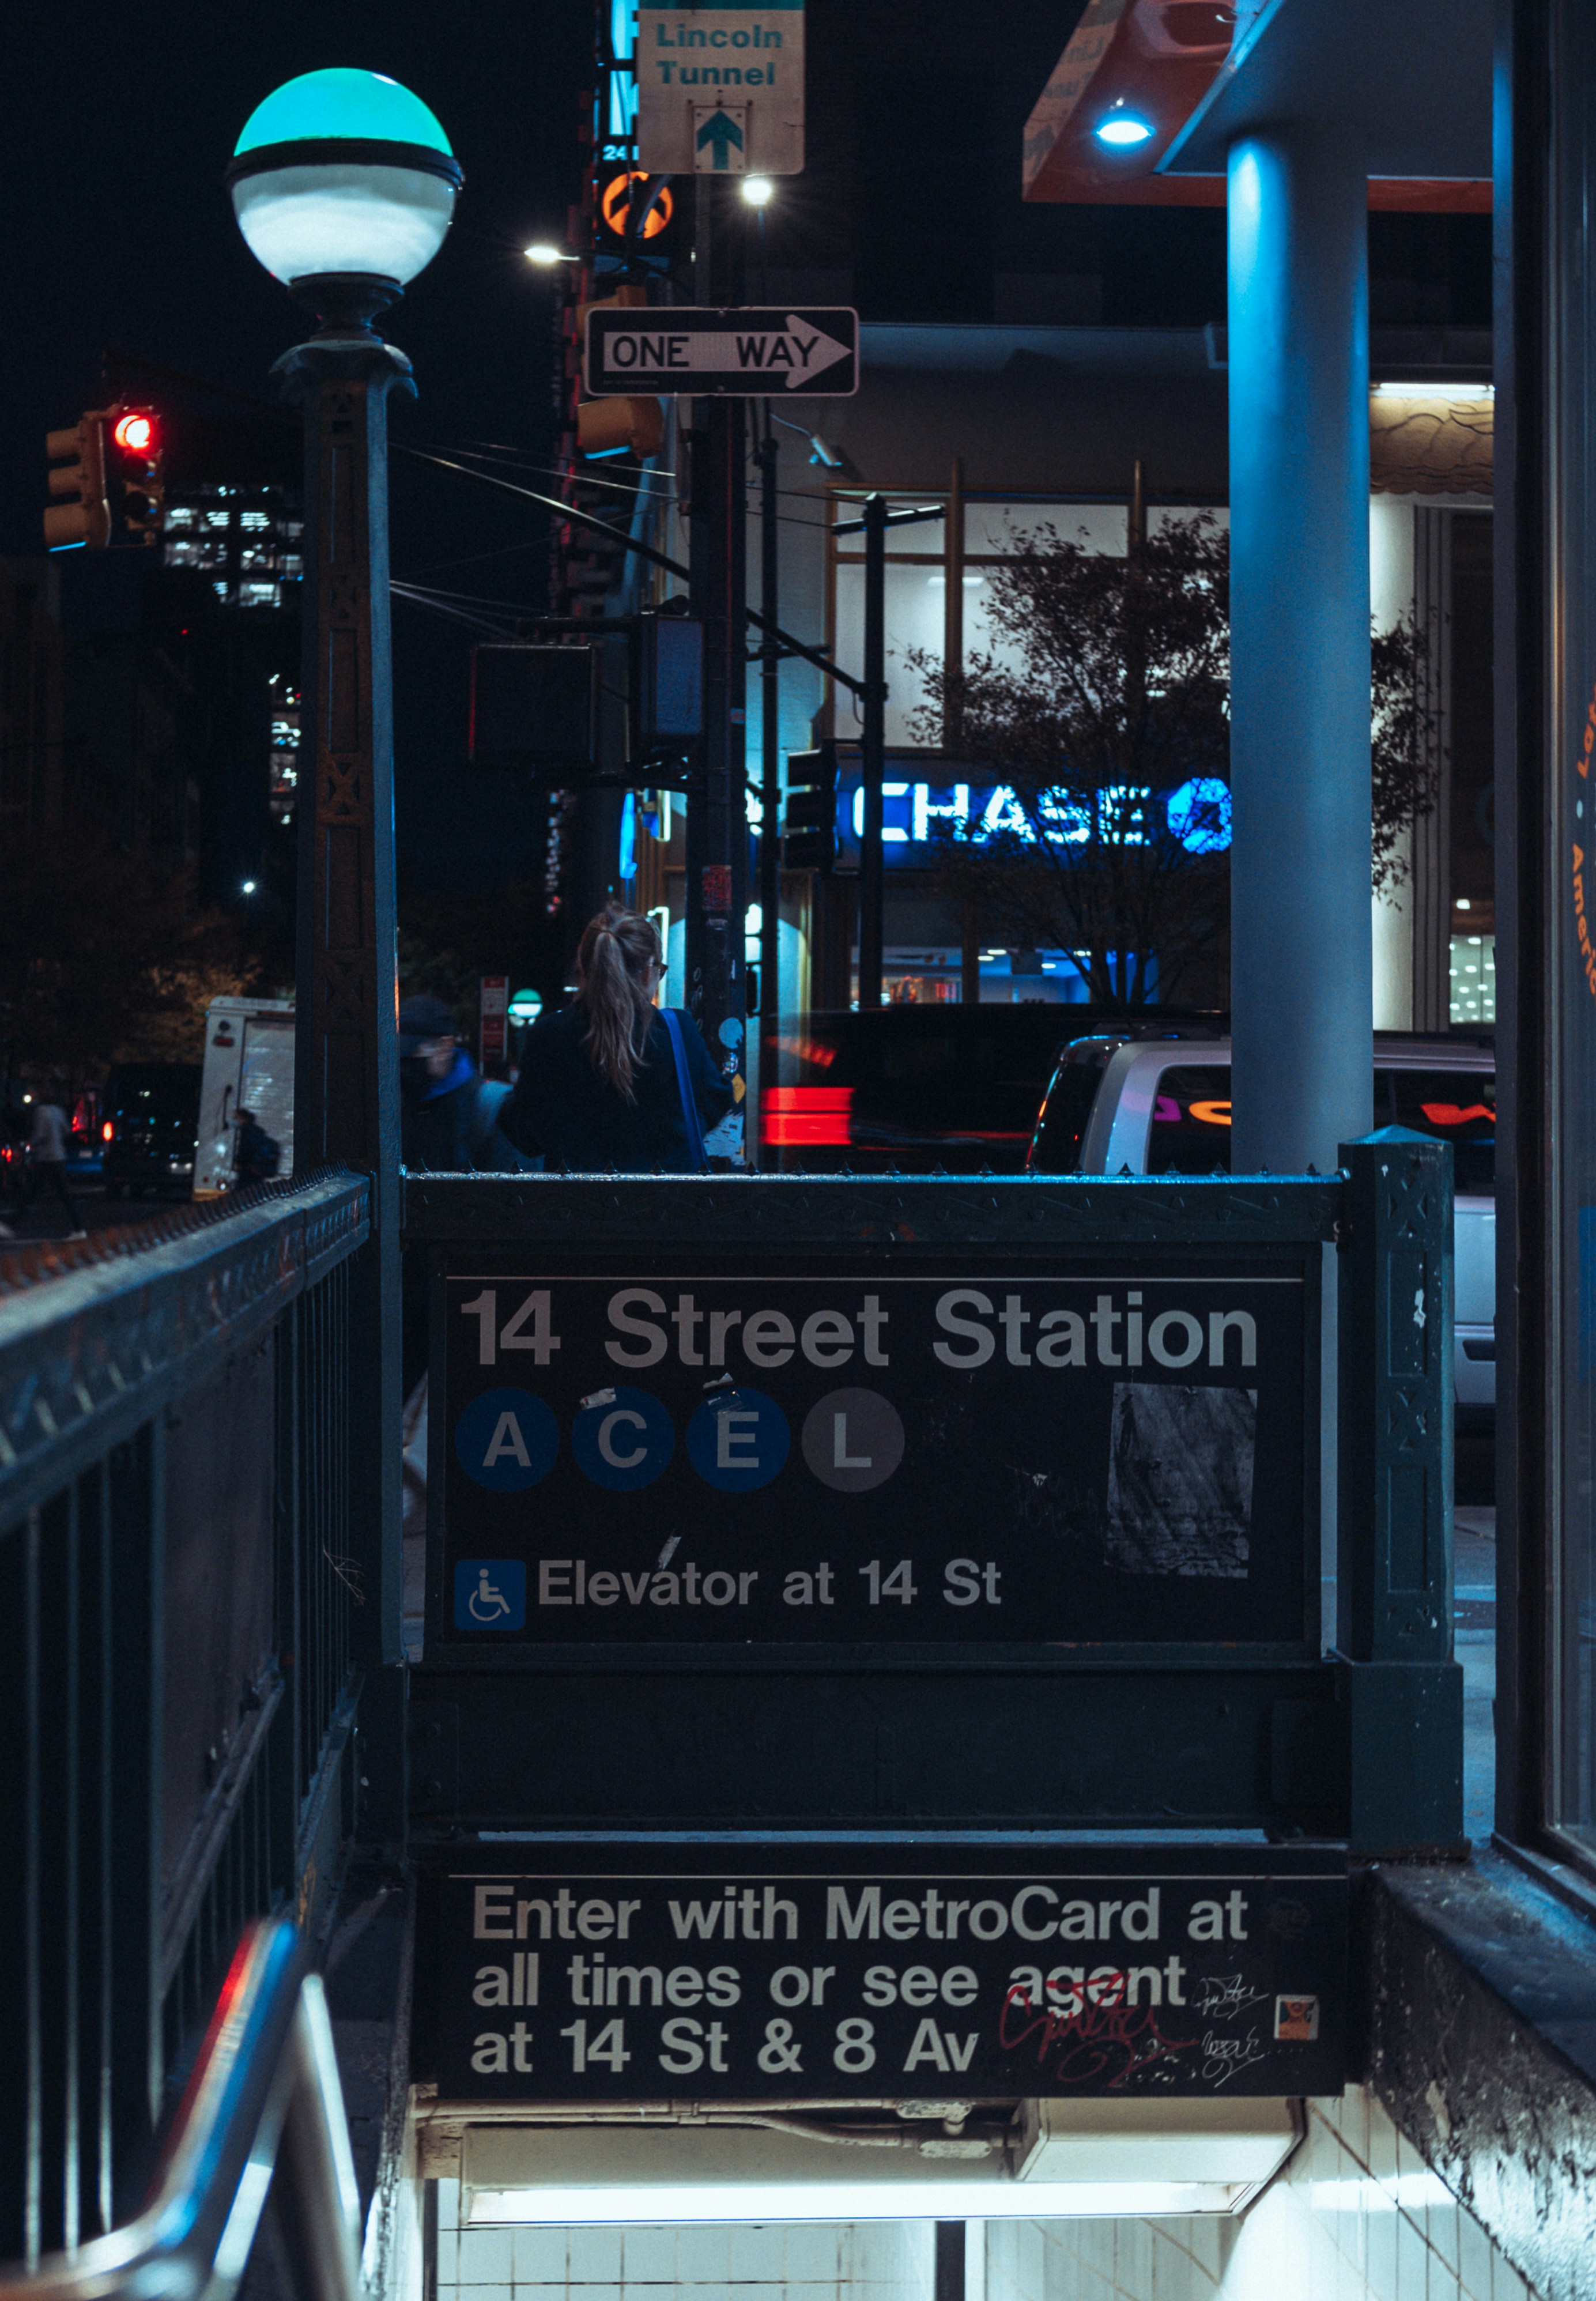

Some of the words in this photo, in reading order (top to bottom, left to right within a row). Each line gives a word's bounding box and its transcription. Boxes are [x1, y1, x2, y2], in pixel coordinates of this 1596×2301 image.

[656, 22, 782, 48] Lincoln
[656, 60, 775, 86] Tunnel
[612, 335, 690, 368] ONE
[735, 335, 819, 368] WAY
[852, 782, 1152, 846] CHASE
[1572, 842, 1596, 1002] Americ
[461, 1290, 561, 1365] 14
[605, 1288, 889, 1368] Street
[933, 1288, 1257, 1369] Station
[482, 1411, 532, 1468] A
[597, 1410, 648, 1469] C
[716, 1412, 760, 1469] E
[833, 1413, 872, 1468] L
[538, 1559, 759, 1606] Elevator
[782, 1562, 835, 1606] at
[858, 1560, 918, 1605] 14
[942, 1558, 1002, 1606] St
[473, 1885, 641, 1940] Enter
[668, 1886, 798, 1940] with
[826, 1885, 1160, 1941] MetroCard
[1187, 1890, 1248, 1941] at
[472, 1952, 539, 2007] all
[567, 1952, 741, 2007] times
[769, 1965, 836, 2007] or
[862, 1965, 979, 2007] see
[1008, 1956, 1186, 2019] agent
[471, 2022, 533, 2073] at
[560, 2019, 631, 2073] 14
[659, 2017, 729, 2074] St
[757, 2018, 804, 2074] &
[833, 2017, 877, 2074] 8
[903, 2018, 980, 2073] Av
